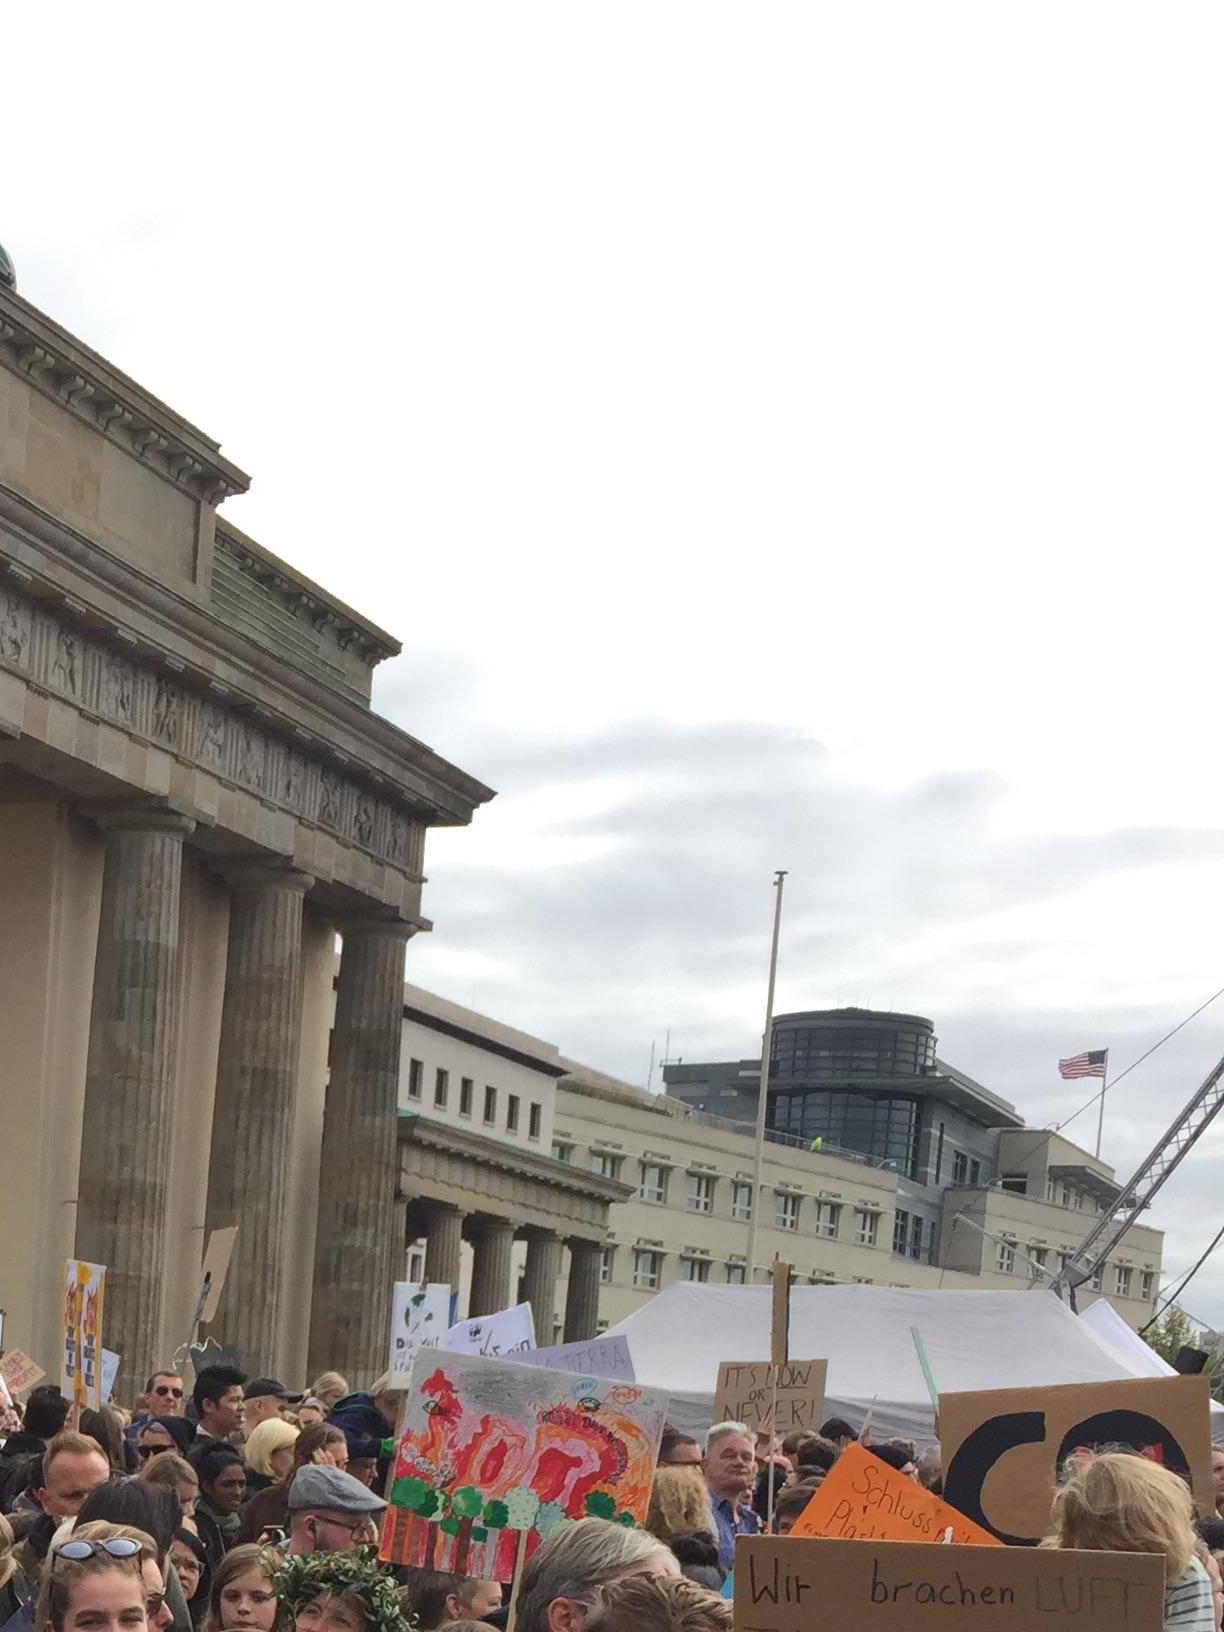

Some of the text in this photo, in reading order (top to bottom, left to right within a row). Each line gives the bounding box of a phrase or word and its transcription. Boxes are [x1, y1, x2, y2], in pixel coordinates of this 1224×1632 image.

[724, 1364, 812, 1389] IT'S NOW
[748, 1387, 766, 1401] OR
[723, 1399, 816, 1426] NEVER!
[851, 1465, 934, 1534] Schluss
[748, 1554, 1147, 1617] Wir brachen LUFT
